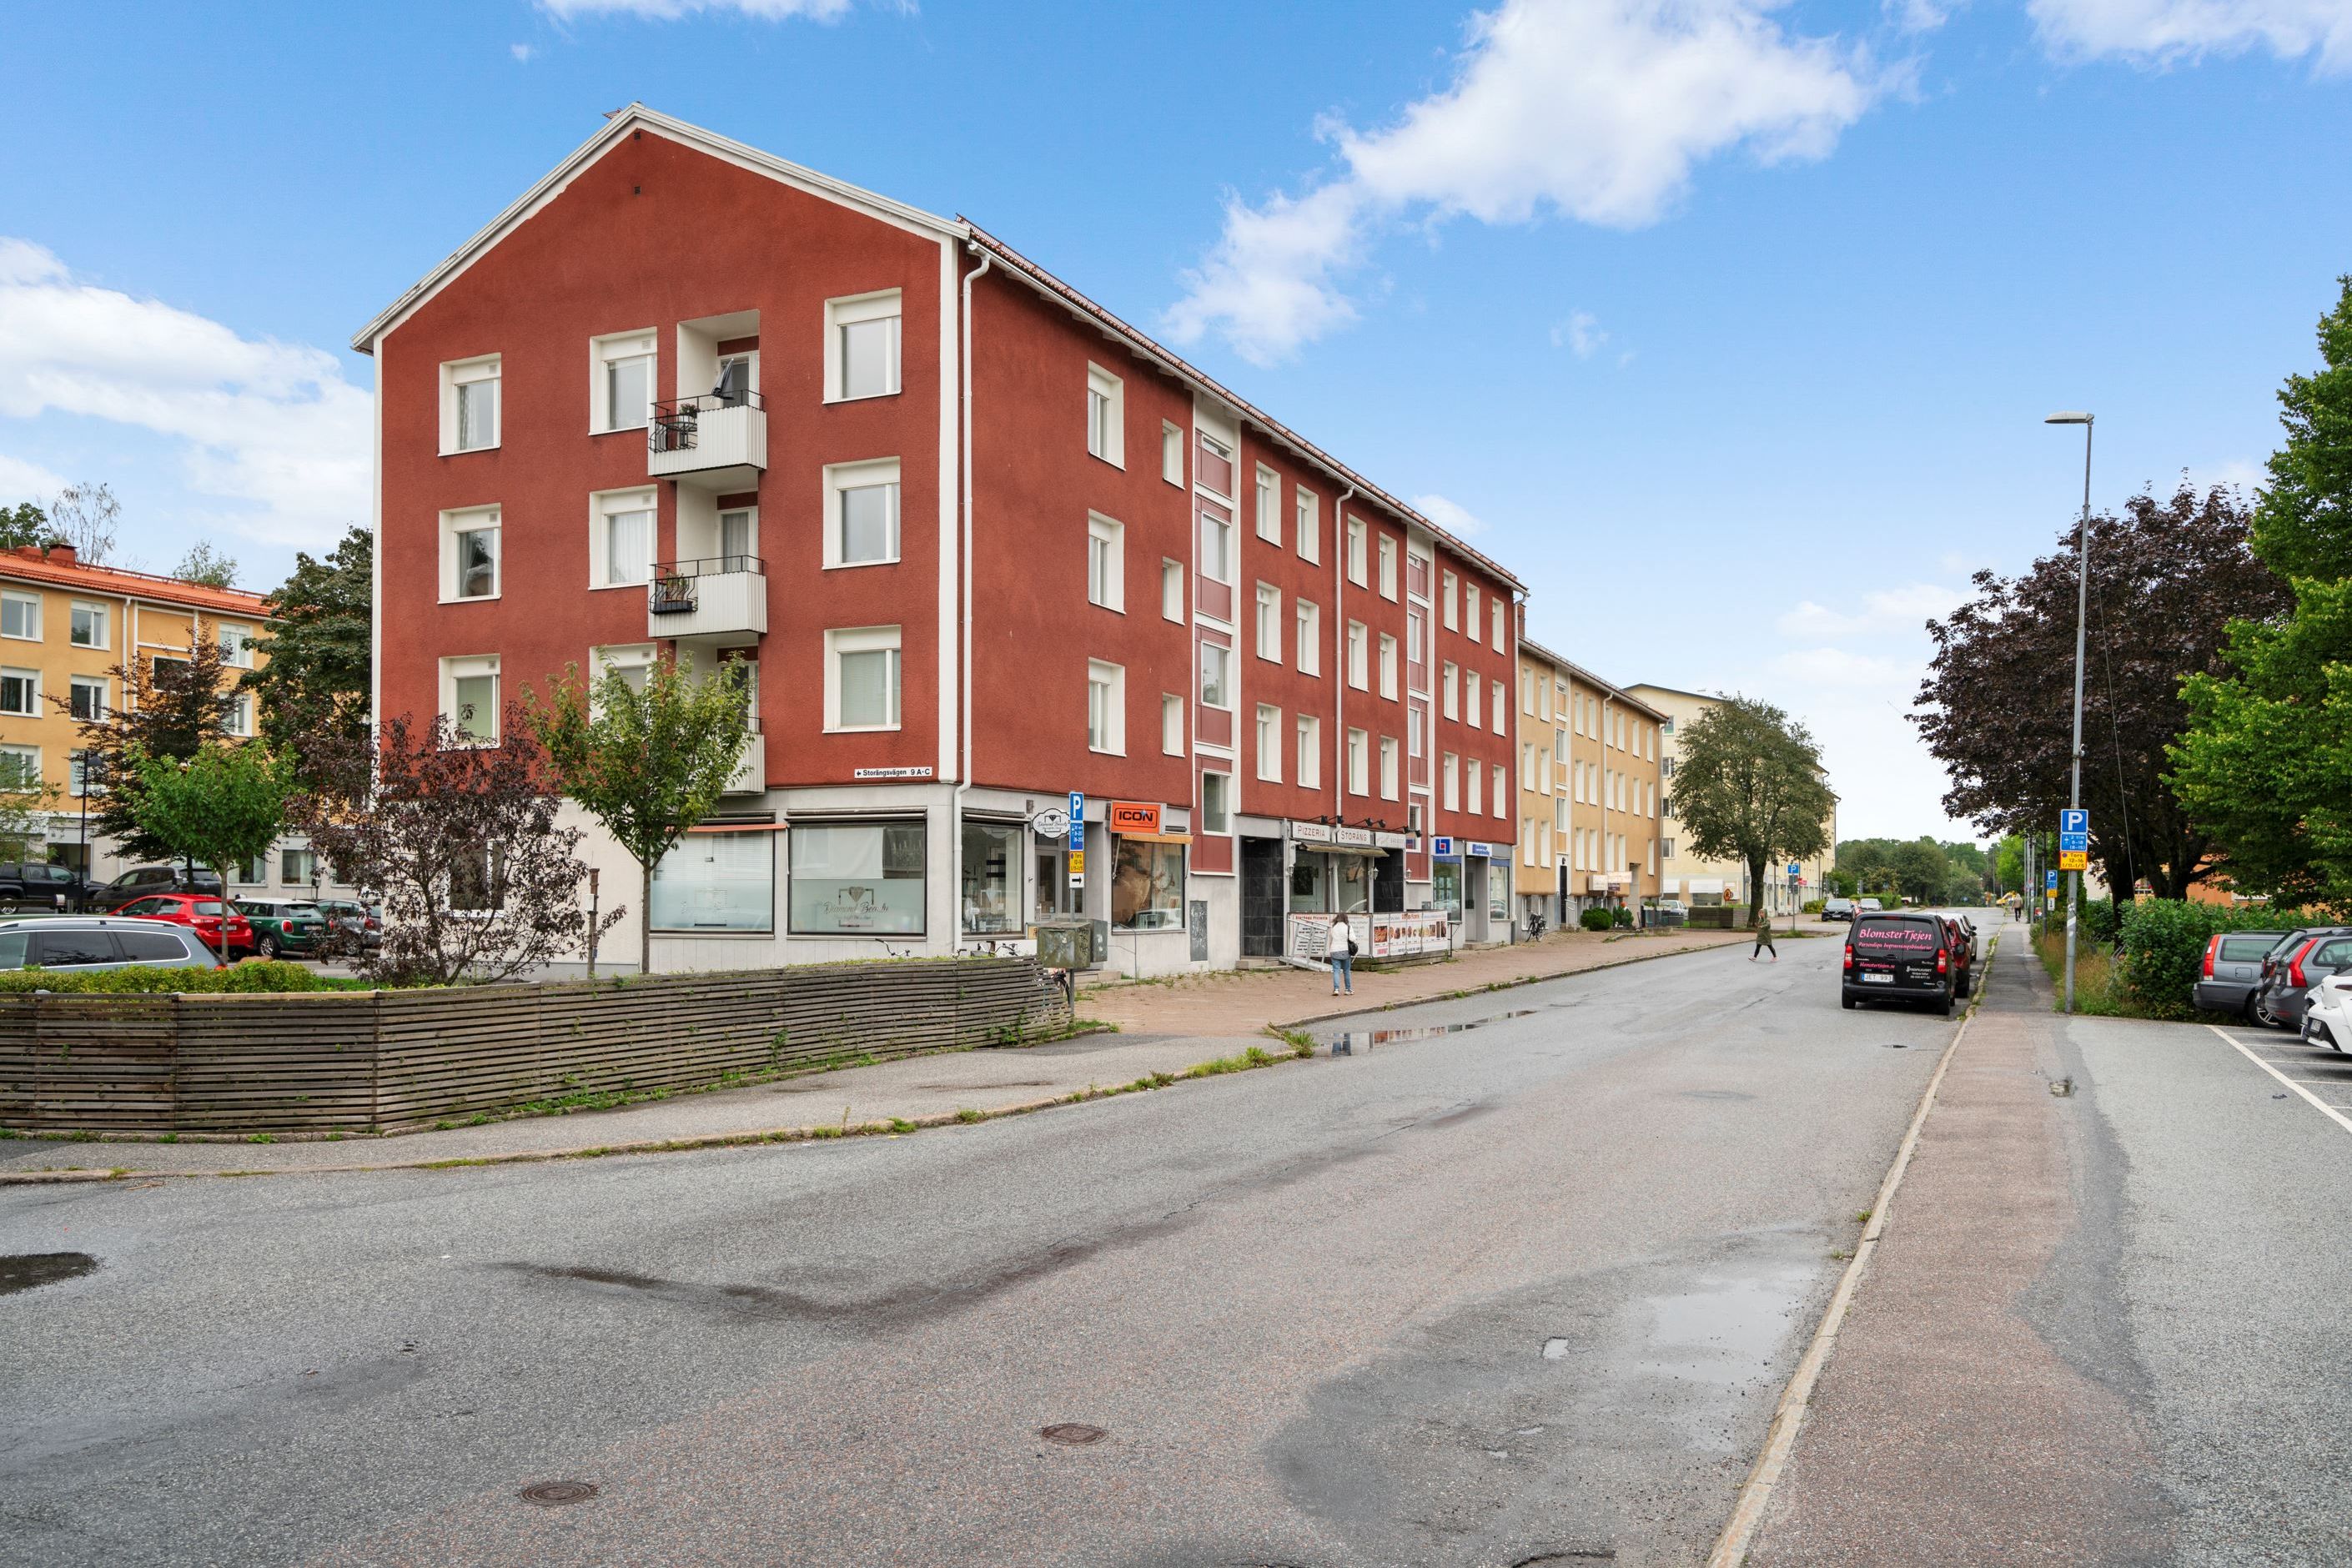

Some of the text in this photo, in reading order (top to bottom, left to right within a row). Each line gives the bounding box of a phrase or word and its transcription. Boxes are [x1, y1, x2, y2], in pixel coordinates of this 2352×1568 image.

[1073, 795, 1082, 818] P
[1118, 811, 1153, 822] ICON
[2068, 812, 2083, 831] P
[1297, 825, 1325, 837] PIZZERIA
[1791, 865, 1797, 874] P
[2048, 871, 2055, 881] P
[1859, 927, 1932, 942] BlomsterTjejen
